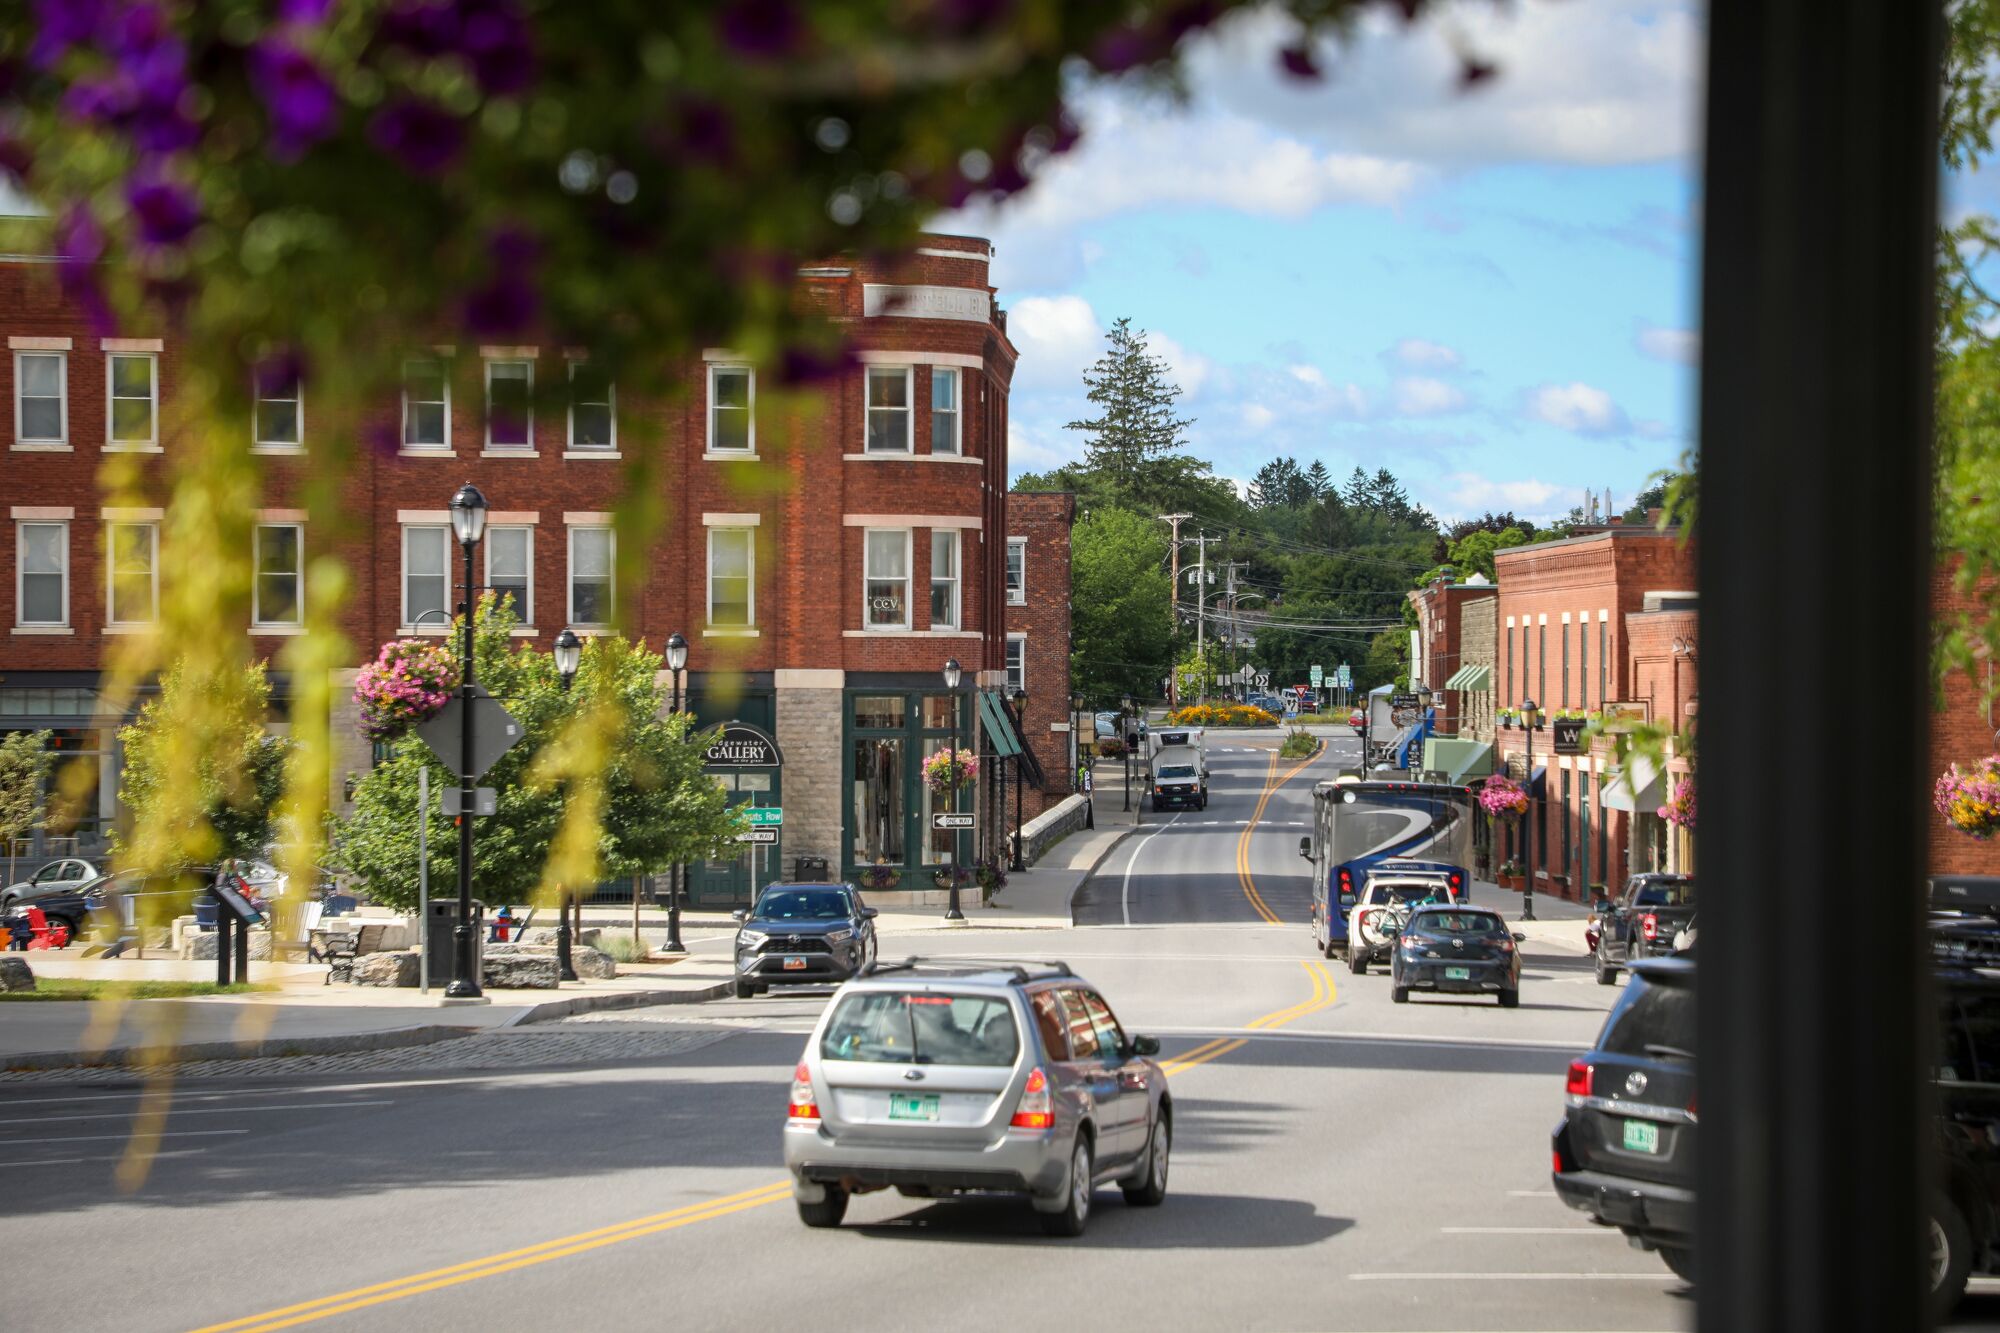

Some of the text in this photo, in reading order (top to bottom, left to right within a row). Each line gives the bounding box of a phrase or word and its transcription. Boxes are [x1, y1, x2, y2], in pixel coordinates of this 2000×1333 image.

[714, 740, 764, 748] dgewater
[707, 746, 768, 759] GALLERY
[765, 812, 781, 821] Row
